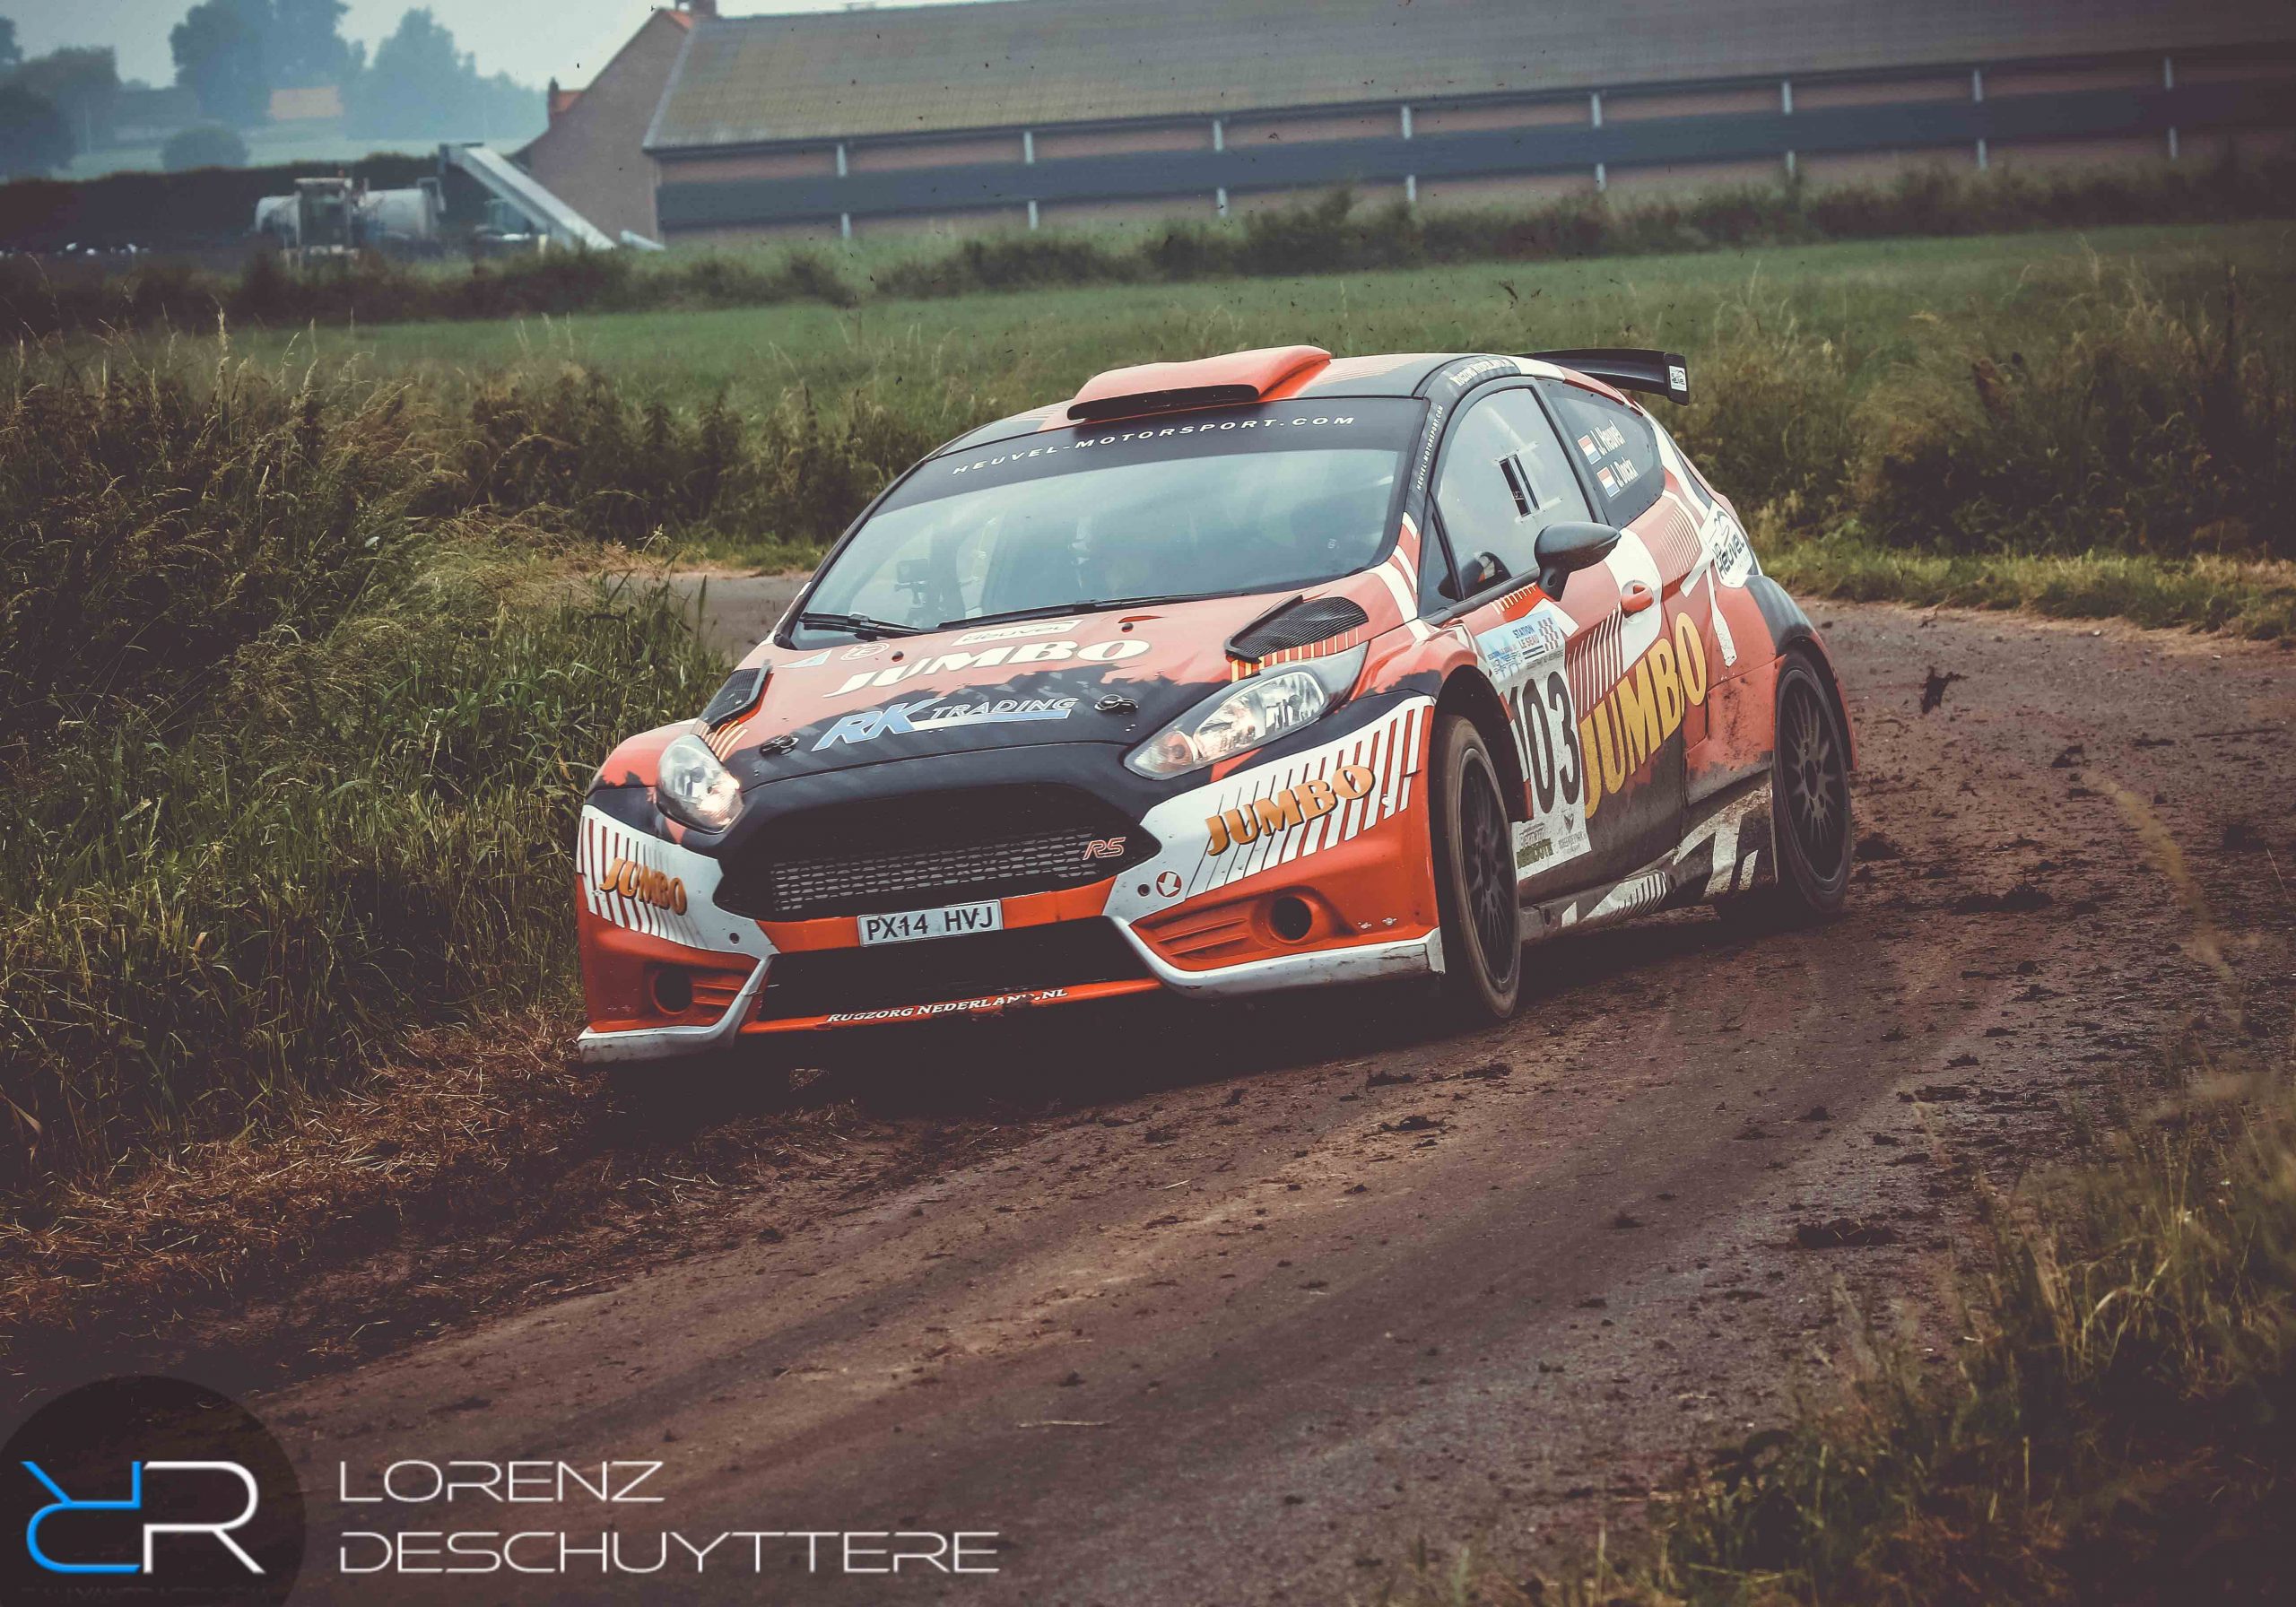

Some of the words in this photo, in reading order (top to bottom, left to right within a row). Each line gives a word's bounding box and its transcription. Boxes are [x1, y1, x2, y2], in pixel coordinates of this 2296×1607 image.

[952, 415, 1355, 475] HEUVEL-MOTORSPORT.COM
[822, 639, 1151, 699] JUMBO
[811, 697, 948, 751] RK
[927, 697, 1080, 720] TRADING
[1580, 612, 1707, 819] JUMBO
[1205, 764, 1376, 856] JUMBO
[599, 856, 688, 916] JUMBO
[866, 914, 929, 941] PX14
[944, 907, 993, 932] HVJ
[916, 988, 1068, 1015] NEDERLAN.NL
